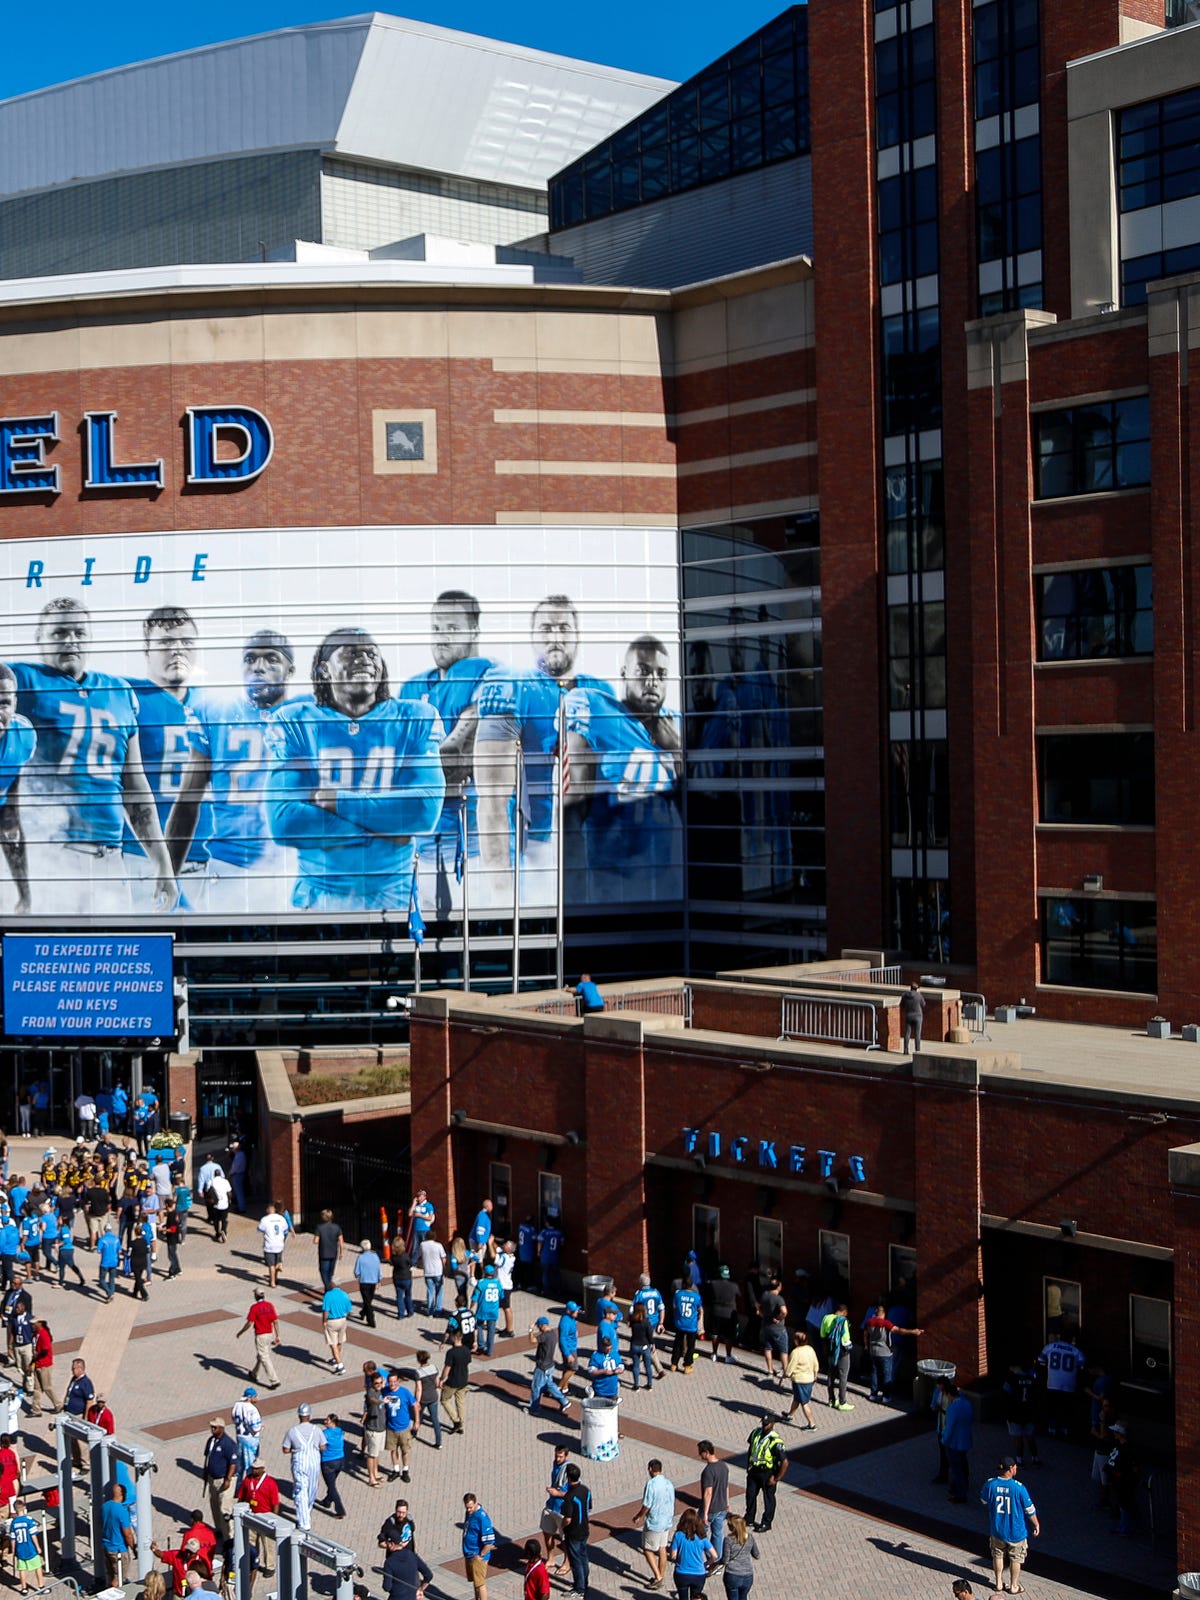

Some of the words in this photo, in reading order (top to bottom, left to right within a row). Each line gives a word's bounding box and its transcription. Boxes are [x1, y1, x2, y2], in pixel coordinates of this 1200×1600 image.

[58, 700, 118, 780] 76
[34, 944, 50, 956] TO
[52, 944, 113, 956] EXPEDITE
[117, 944, 140, 956] THE
[20, 962, 90, 974] SCREENING
[94, 962, 154, 976] PROCESS,
[12, 980, 56, 992] PLEASE
[60, 980, 111, 992] REMOVE
[113, 980, 163, 992] PHONES
[57, 998, 82, 1010] AND
[86, 998, 118, 1010] KEYS
[21, 1016, 56, 1028] FROM
[60, 1016, 92, 1029] YOUR
[95, 1016, 152, 1029] POCKETS
[681, 1126, 867, 1183] TICKETS
[484, 1288, 498, 1303] 68
[647, 1299, 655, 1315] 9
[681, 1303, 692, 1318] 15
[460, 1317, 474, 1335] 68
[1049, 1351, 1075, 1371] 80
[995, 1496, 1011, 1515] 21
